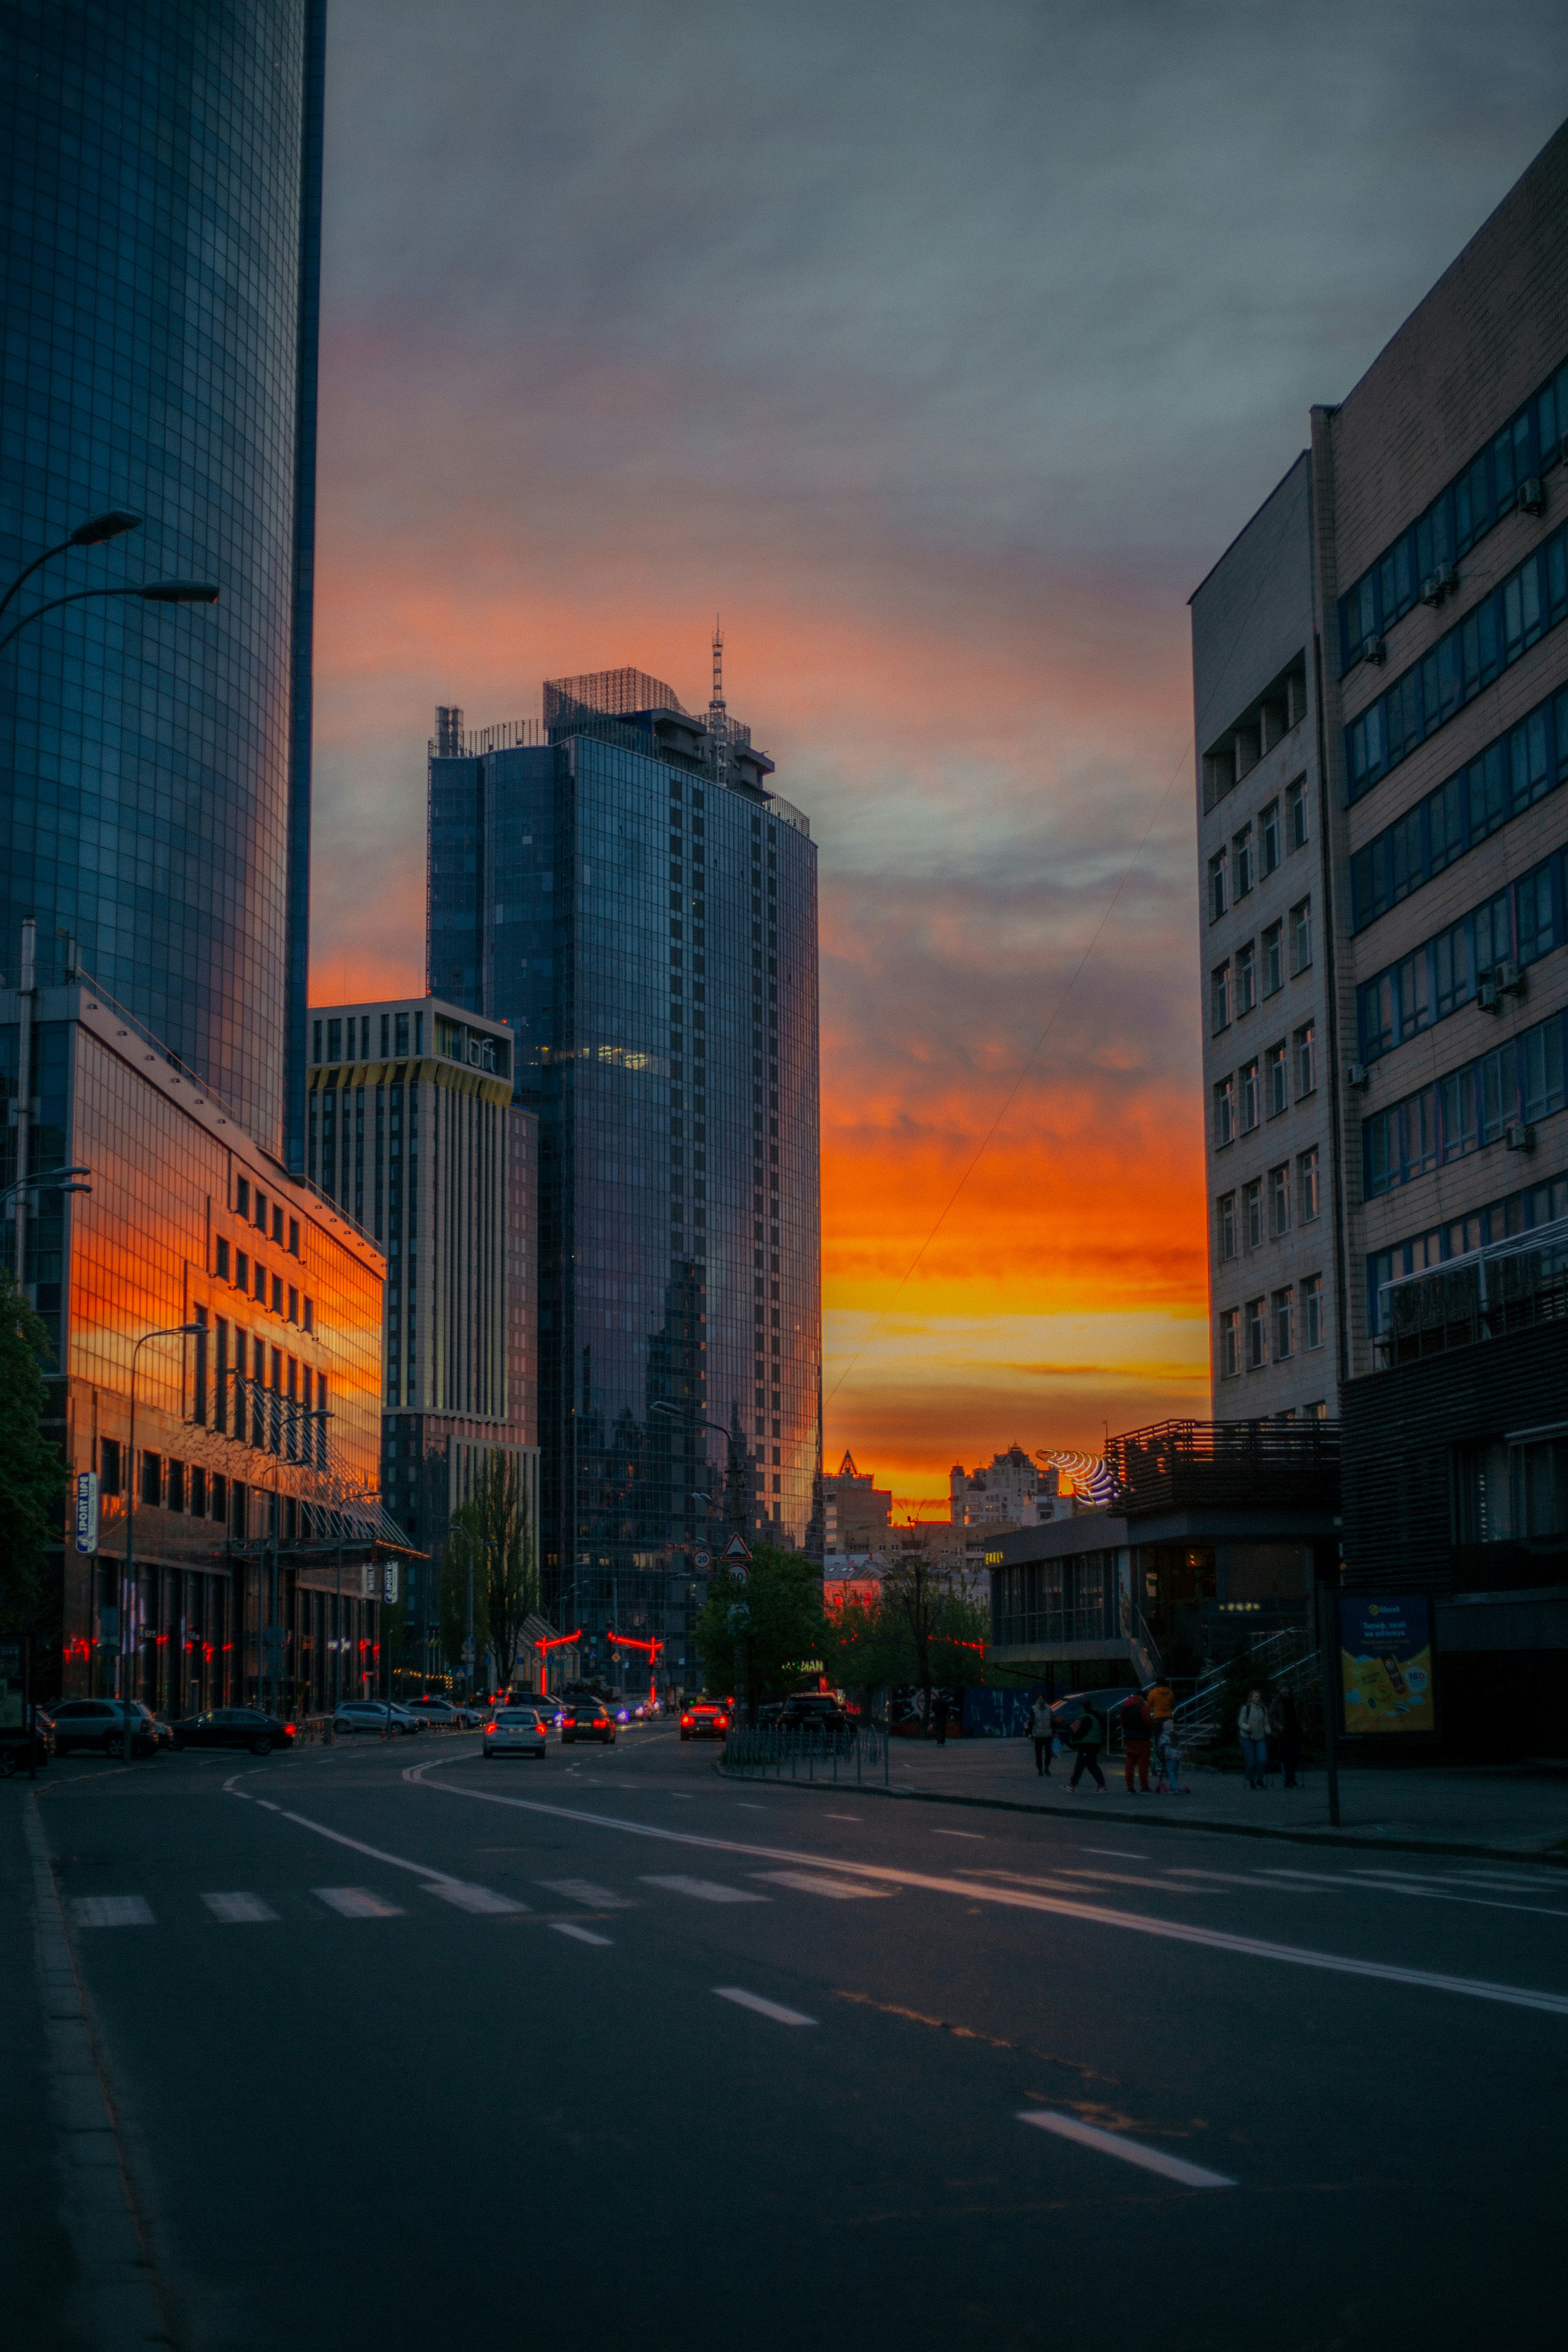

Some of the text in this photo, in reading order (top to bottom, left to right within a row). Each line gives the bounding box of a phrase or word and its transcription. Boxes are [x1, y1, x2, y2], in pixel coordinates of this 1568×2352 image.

[465, 1025, 496, 1073] loft
[79, 1476, 89, 1531] SPORT LIFE
